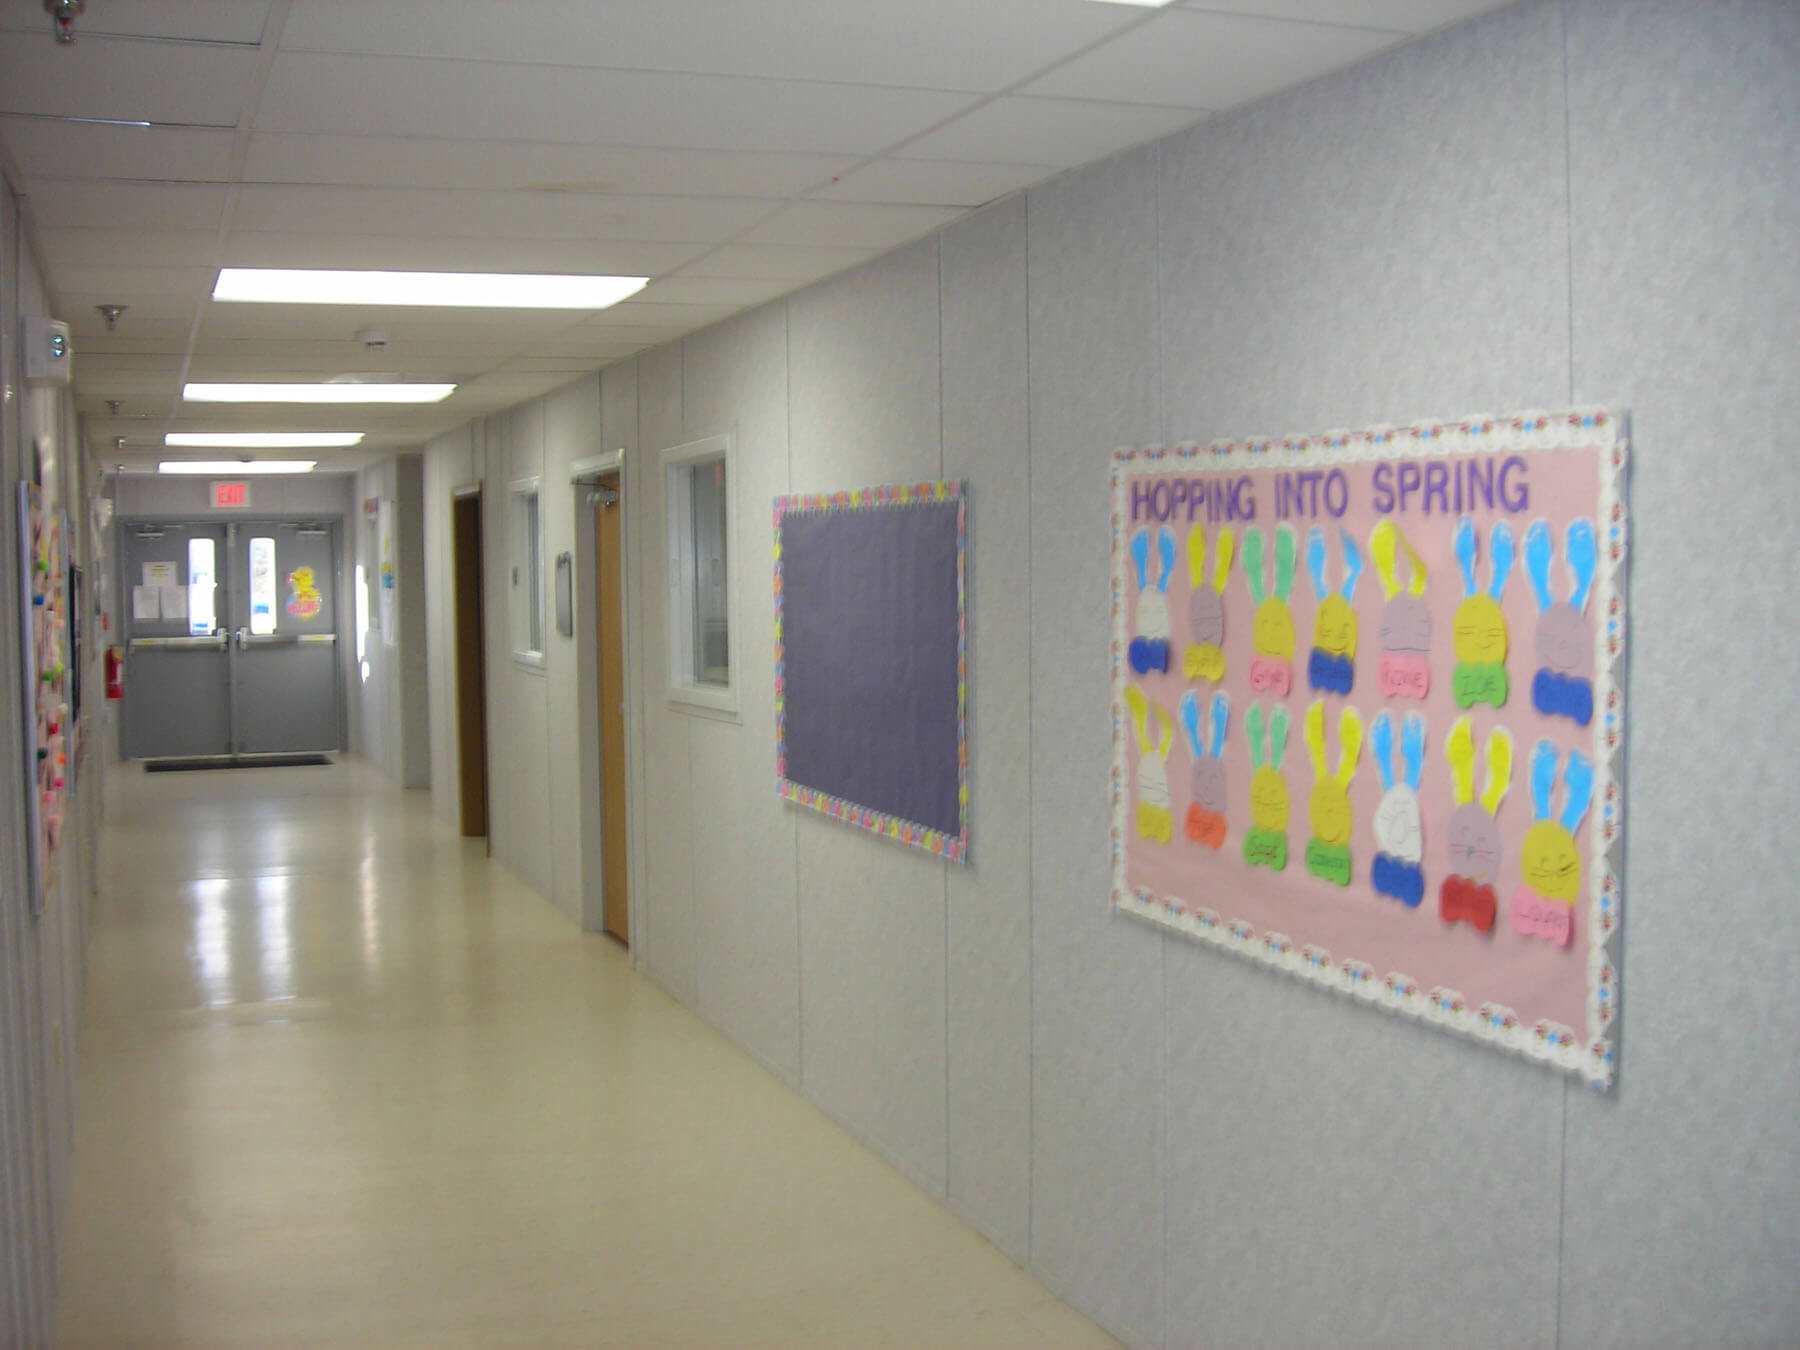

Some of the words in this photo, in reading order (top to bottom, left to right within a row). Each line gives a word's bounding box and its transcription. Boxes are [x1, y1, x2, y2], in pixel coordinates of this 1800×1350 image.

[215, 483, 246, 506] EXIT
[1131, 475, 1256, 522] HOPPING
[1275, 468, 1348, 519] INTO
[1372, 456, 1530, 514] SPRING
